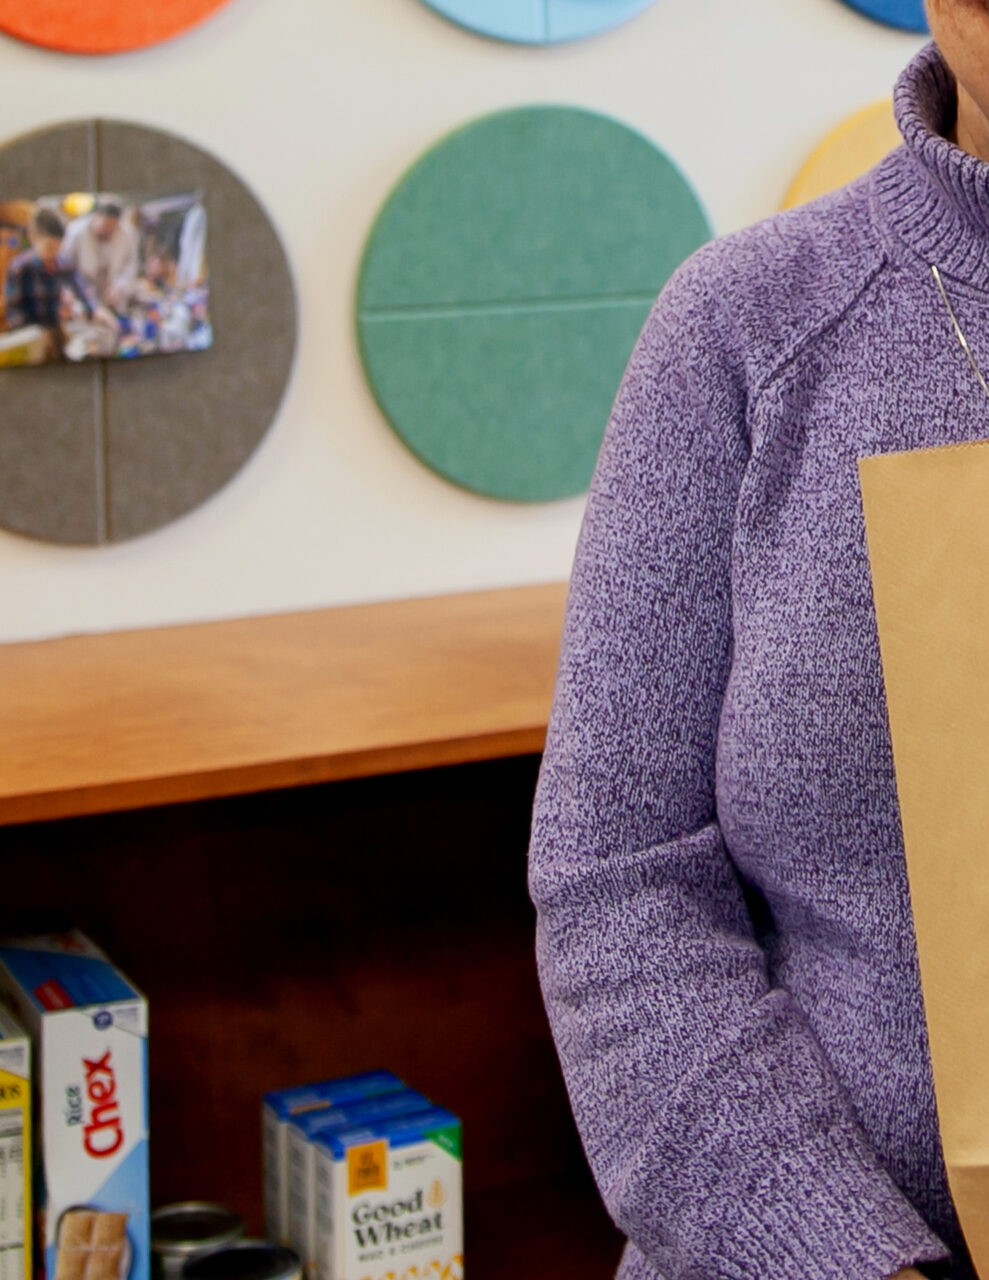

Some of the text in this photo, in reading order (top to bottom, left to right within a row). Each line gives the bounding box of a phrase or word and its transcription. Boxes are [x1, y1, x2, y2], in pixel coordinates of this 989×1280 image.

[81, 1051, 124, 1160] Chex
[352, 1187, 424, 1226] Good
[354, 1211, 443, 1249] Wheat
